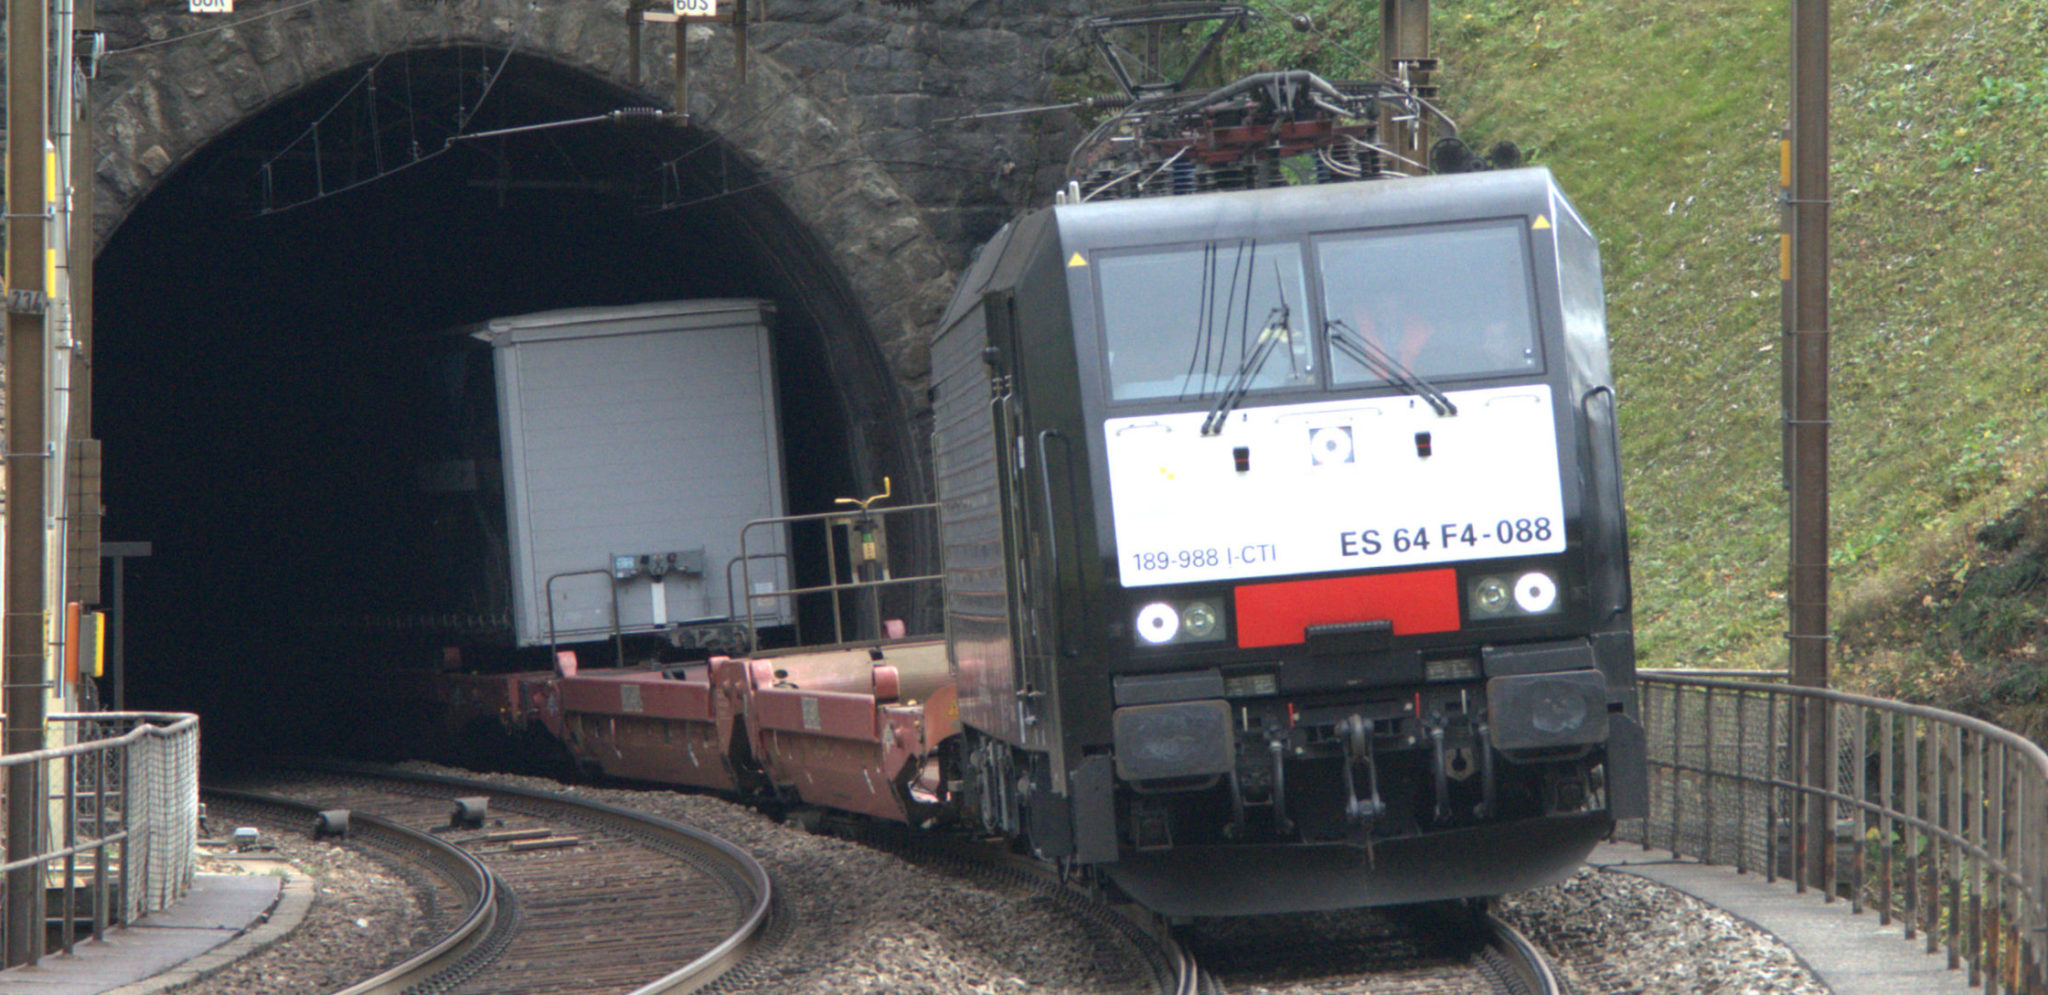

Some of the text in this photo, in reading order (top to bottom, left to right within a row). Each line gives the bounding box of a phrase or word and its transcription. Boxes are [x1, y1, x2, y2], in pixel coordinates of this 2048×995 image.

[1340, 529, 1382, 557] ES
[1393, 526, 1430, 553] 64
[1132, 544, 1276, 570] 189-988 I-CTI
